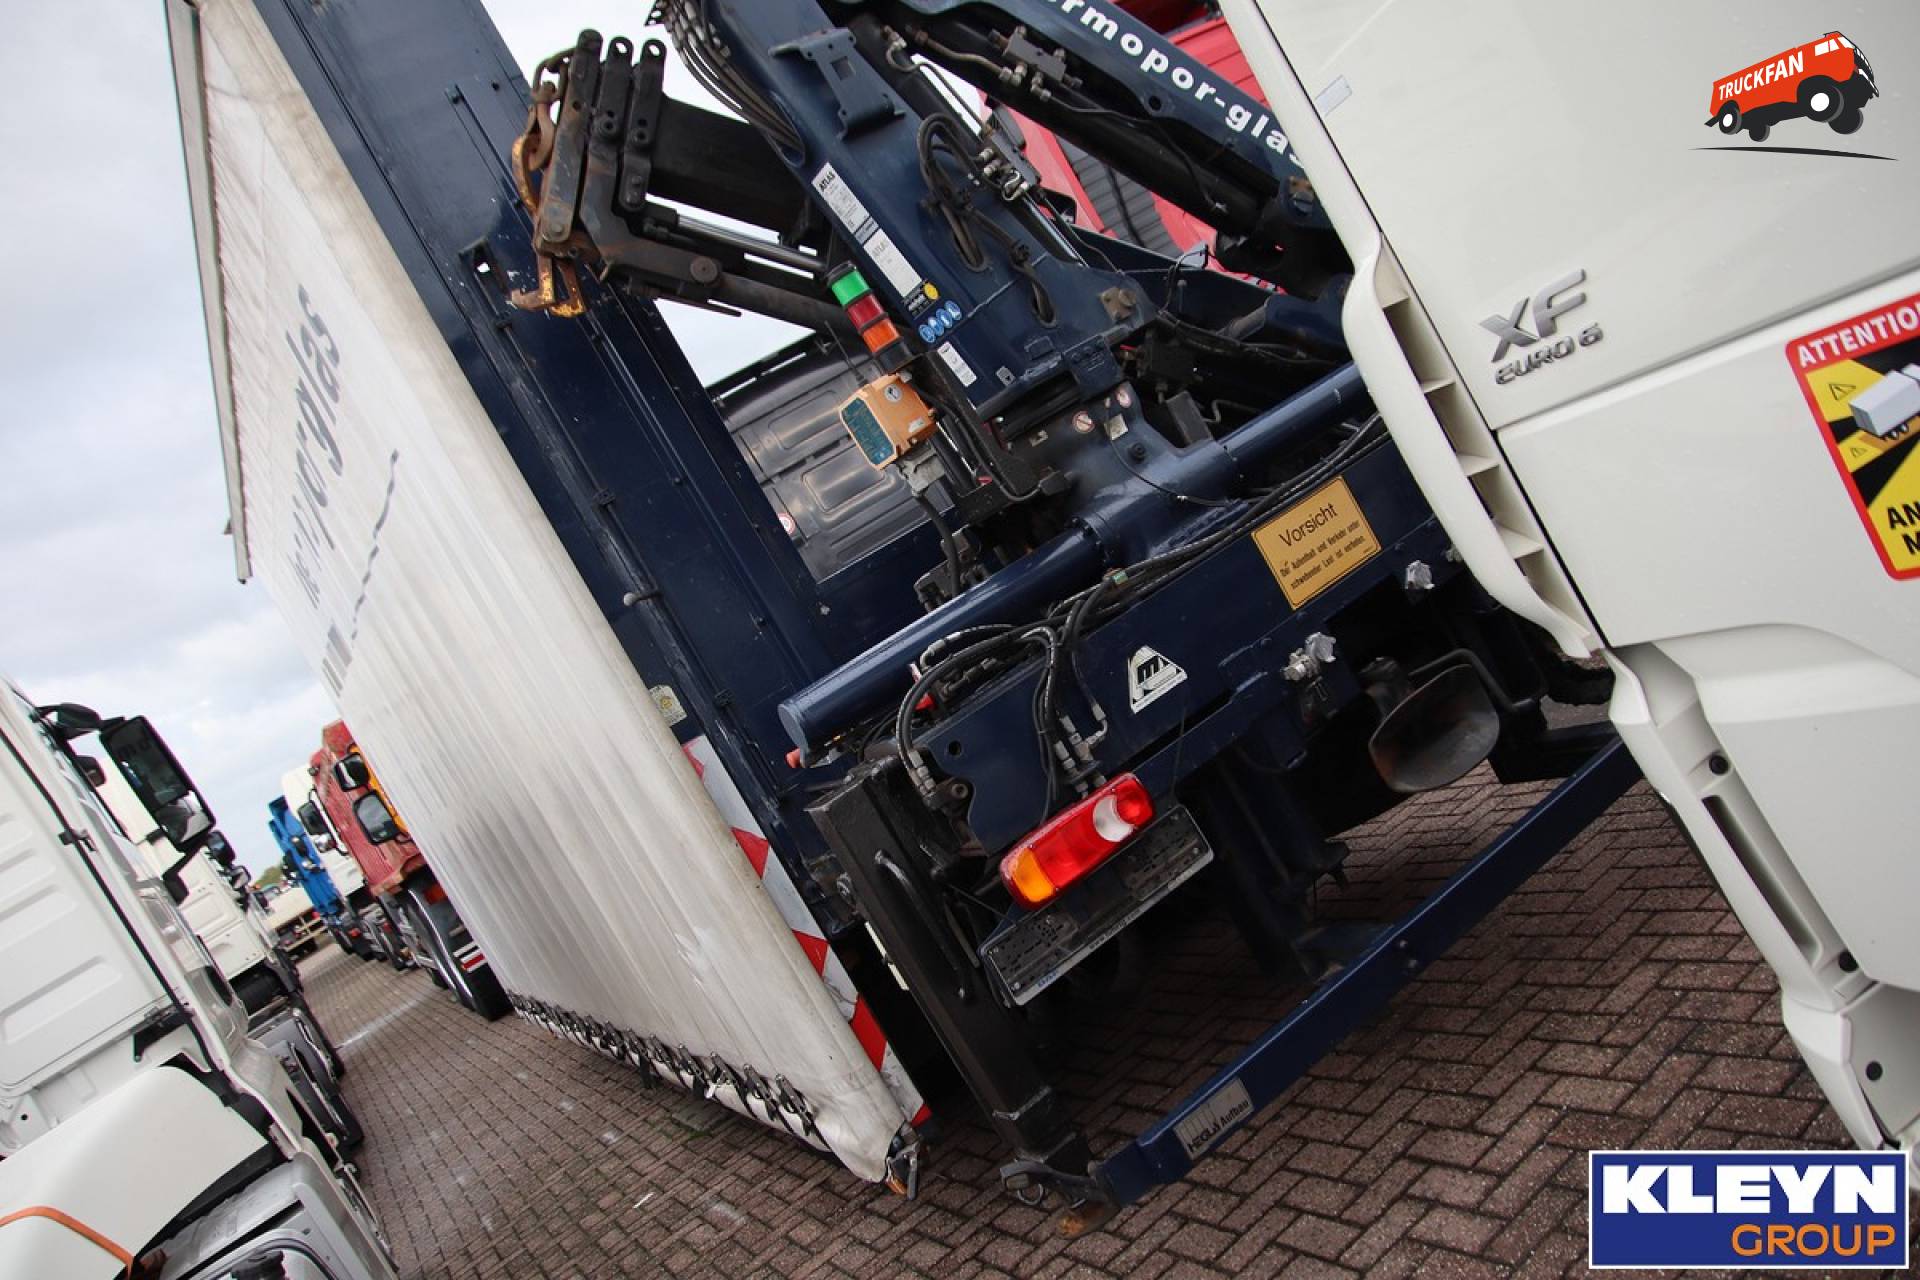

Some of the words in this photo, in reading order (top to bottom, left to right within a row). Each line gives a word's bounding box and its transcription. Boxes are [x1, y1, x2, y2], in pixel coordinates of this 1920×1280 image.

[1046, 0, 1305, 169] rmopor-gla
[1479, 268, 1587, 363] XF
[1798, 302, 1920, 368] ATTENTIO
[1495, 335, 1575, 385] EURO
[1578, 321, 1604, 347] 6
[1278, 502, 1338, 547] Vorsicht
